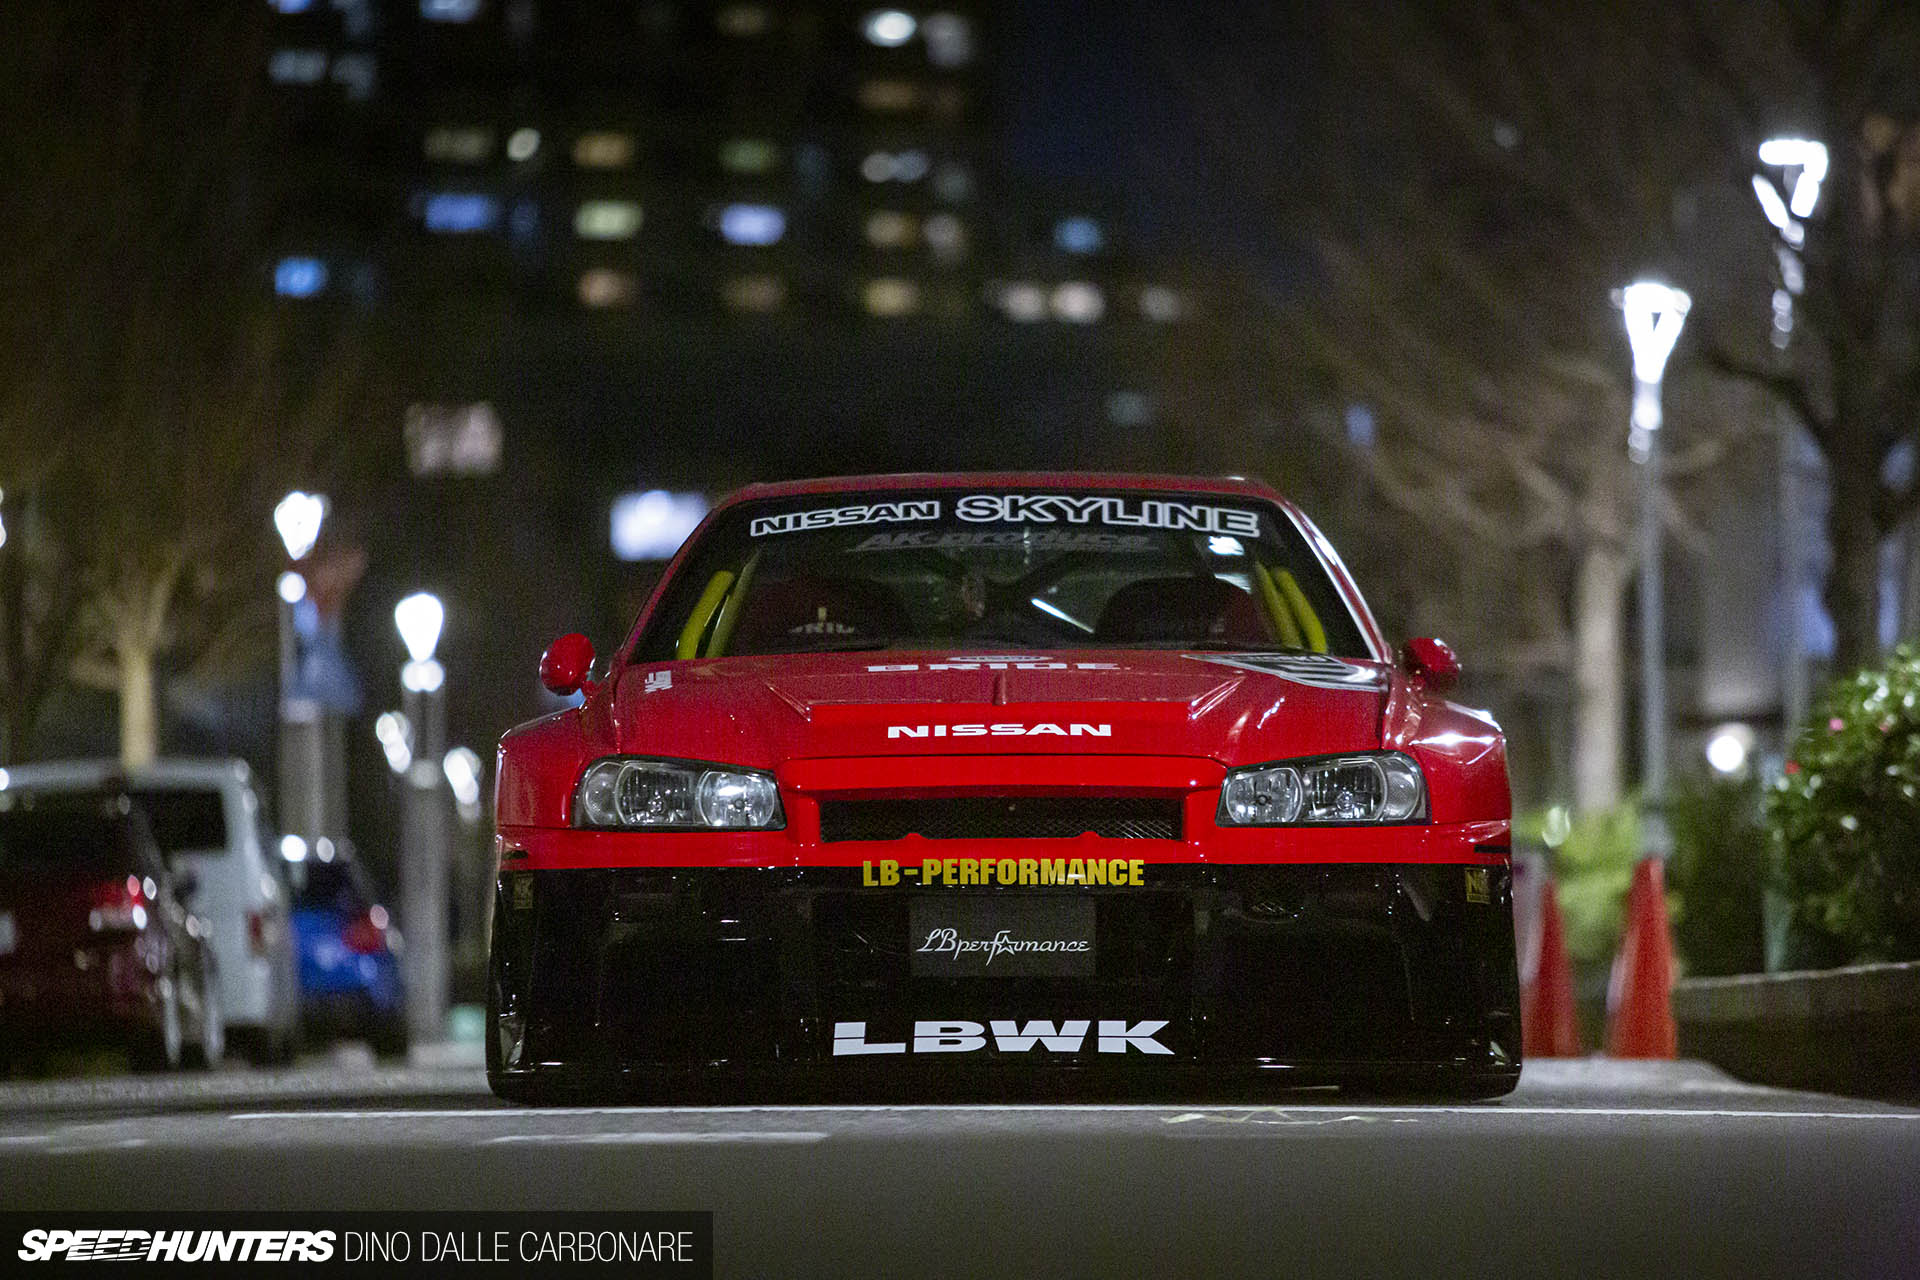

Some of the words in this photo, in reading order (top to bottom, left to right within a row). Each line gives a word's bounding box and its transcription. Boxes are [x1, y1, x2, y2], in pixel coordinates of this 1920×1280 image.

[750, 500, 940, 537] NISSAN
[955, 495, 1261, 537] SKYLINE
[887, 723, 1112, 738] NISSAN
[863, 858, 1145, 886] LB-PERFORMANCE
[833, 1020, 1175, 1056] LBWK
